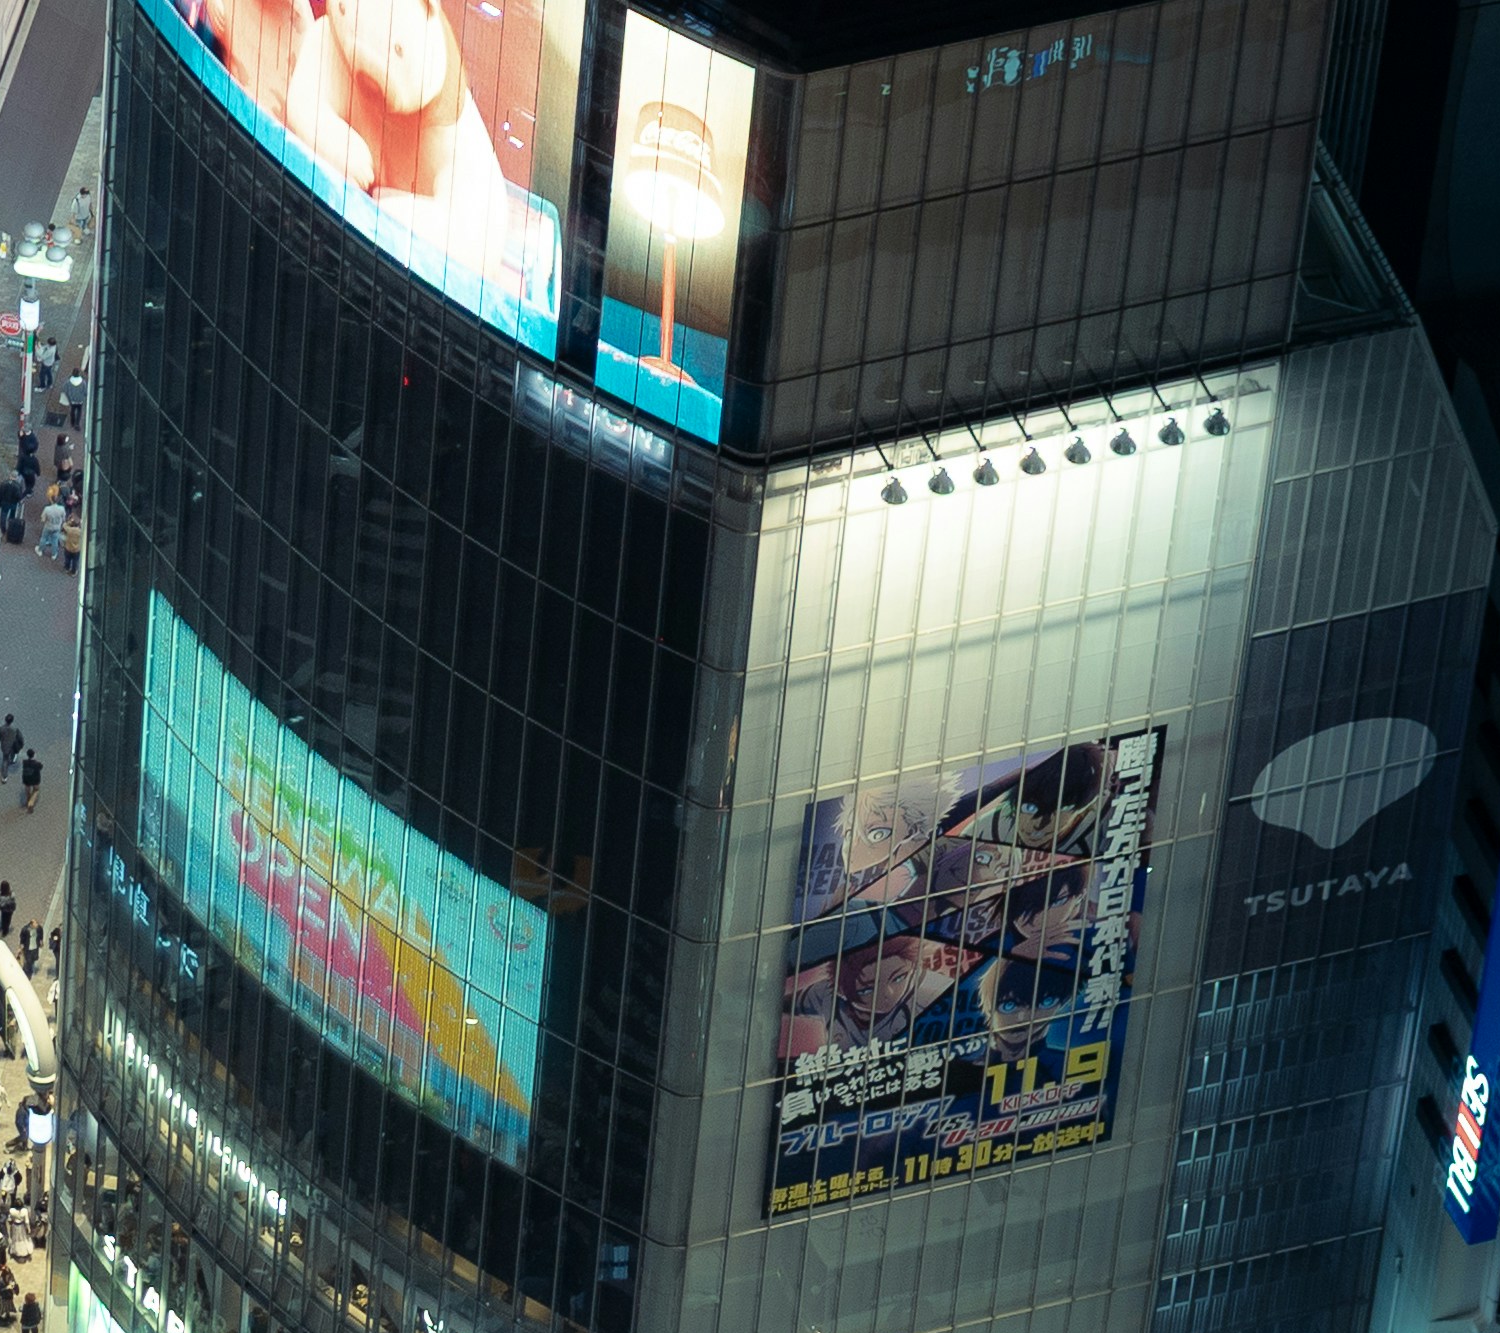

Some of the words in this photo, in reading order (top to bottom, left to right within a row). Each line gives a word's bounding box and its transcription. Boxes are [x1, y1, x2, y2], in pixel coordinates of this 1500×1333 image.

[226, 752, 432, 950] RENEWAL
[227, 798, 362, 958] OPEN
[1244, 863, 1414, 916] TSUTAYA
[794, 1037, 908, 1086] 絶対に
[840, 1072, 942, 1106] そこにはある
[1001, 1091, 1041, 1113] KICK
[1045, 1081, 1083, 1101] OFF
[779, 1095, 955, 1156] ブルーロック
[943, 1116, 1016, 1147] U-20
[1018, 1096, 1106, 1131] JAPAN
[1447, 1056, 1490, 1213] SEIBU
